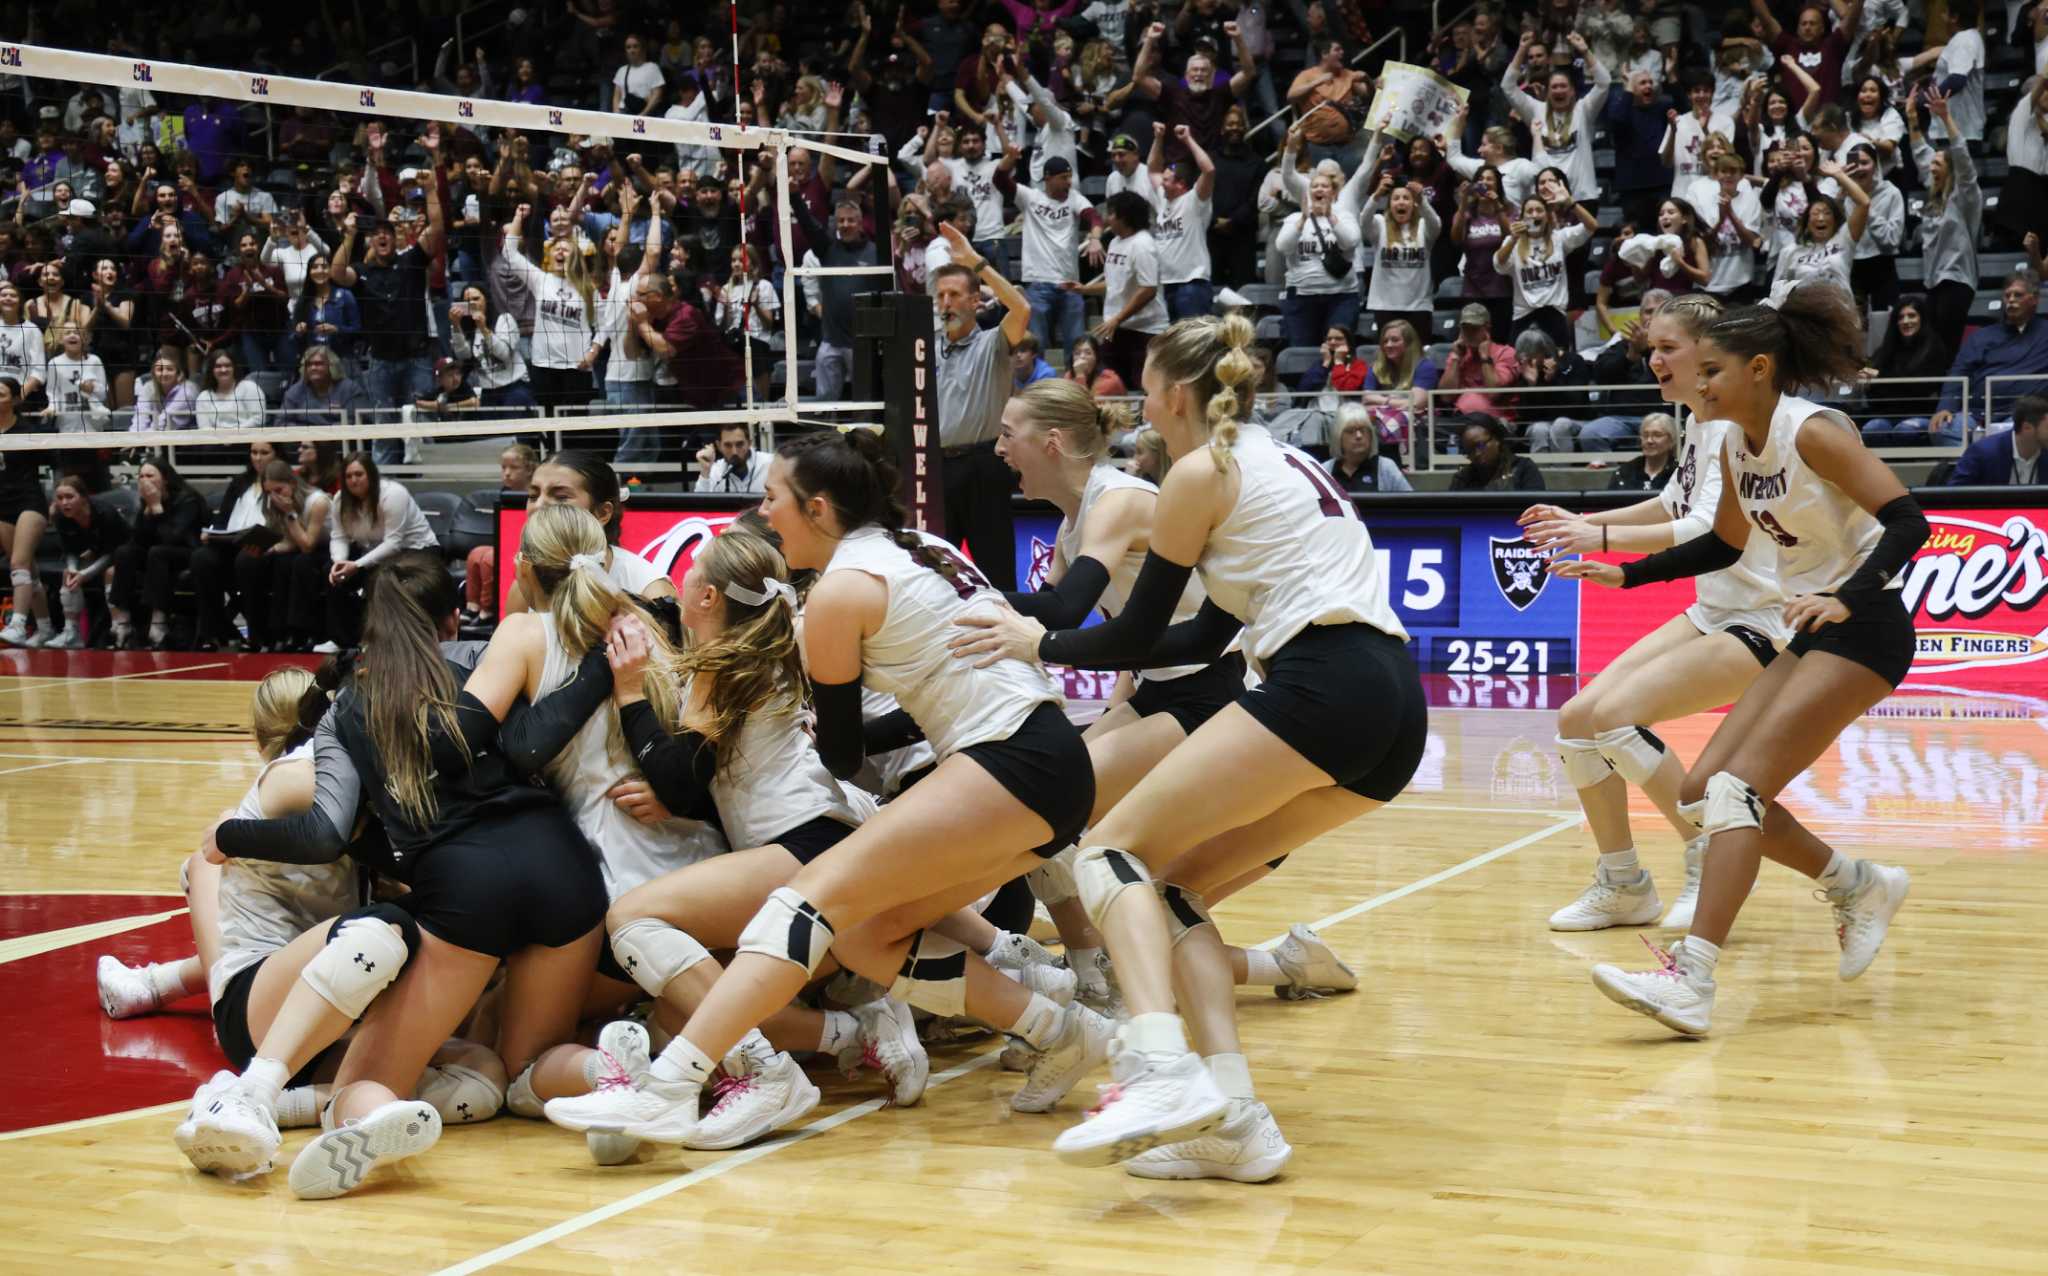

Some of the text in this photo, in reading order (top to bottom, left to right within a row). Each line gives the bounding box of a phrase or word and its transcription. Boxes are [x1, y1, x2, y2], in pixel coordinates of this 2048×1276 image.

[133, 62, 153, 82] UIL
[1034, 204, 1070, 220] STATE
[559, 304, 583, 320] TIME
[913, 338, 928, 531] CULWELL
[1494, 547, 1551, 559] RAIDERS
[1914, 637, 2029, 652] EN FINGERS
[1447, 640, 1548, 672] 25-21
